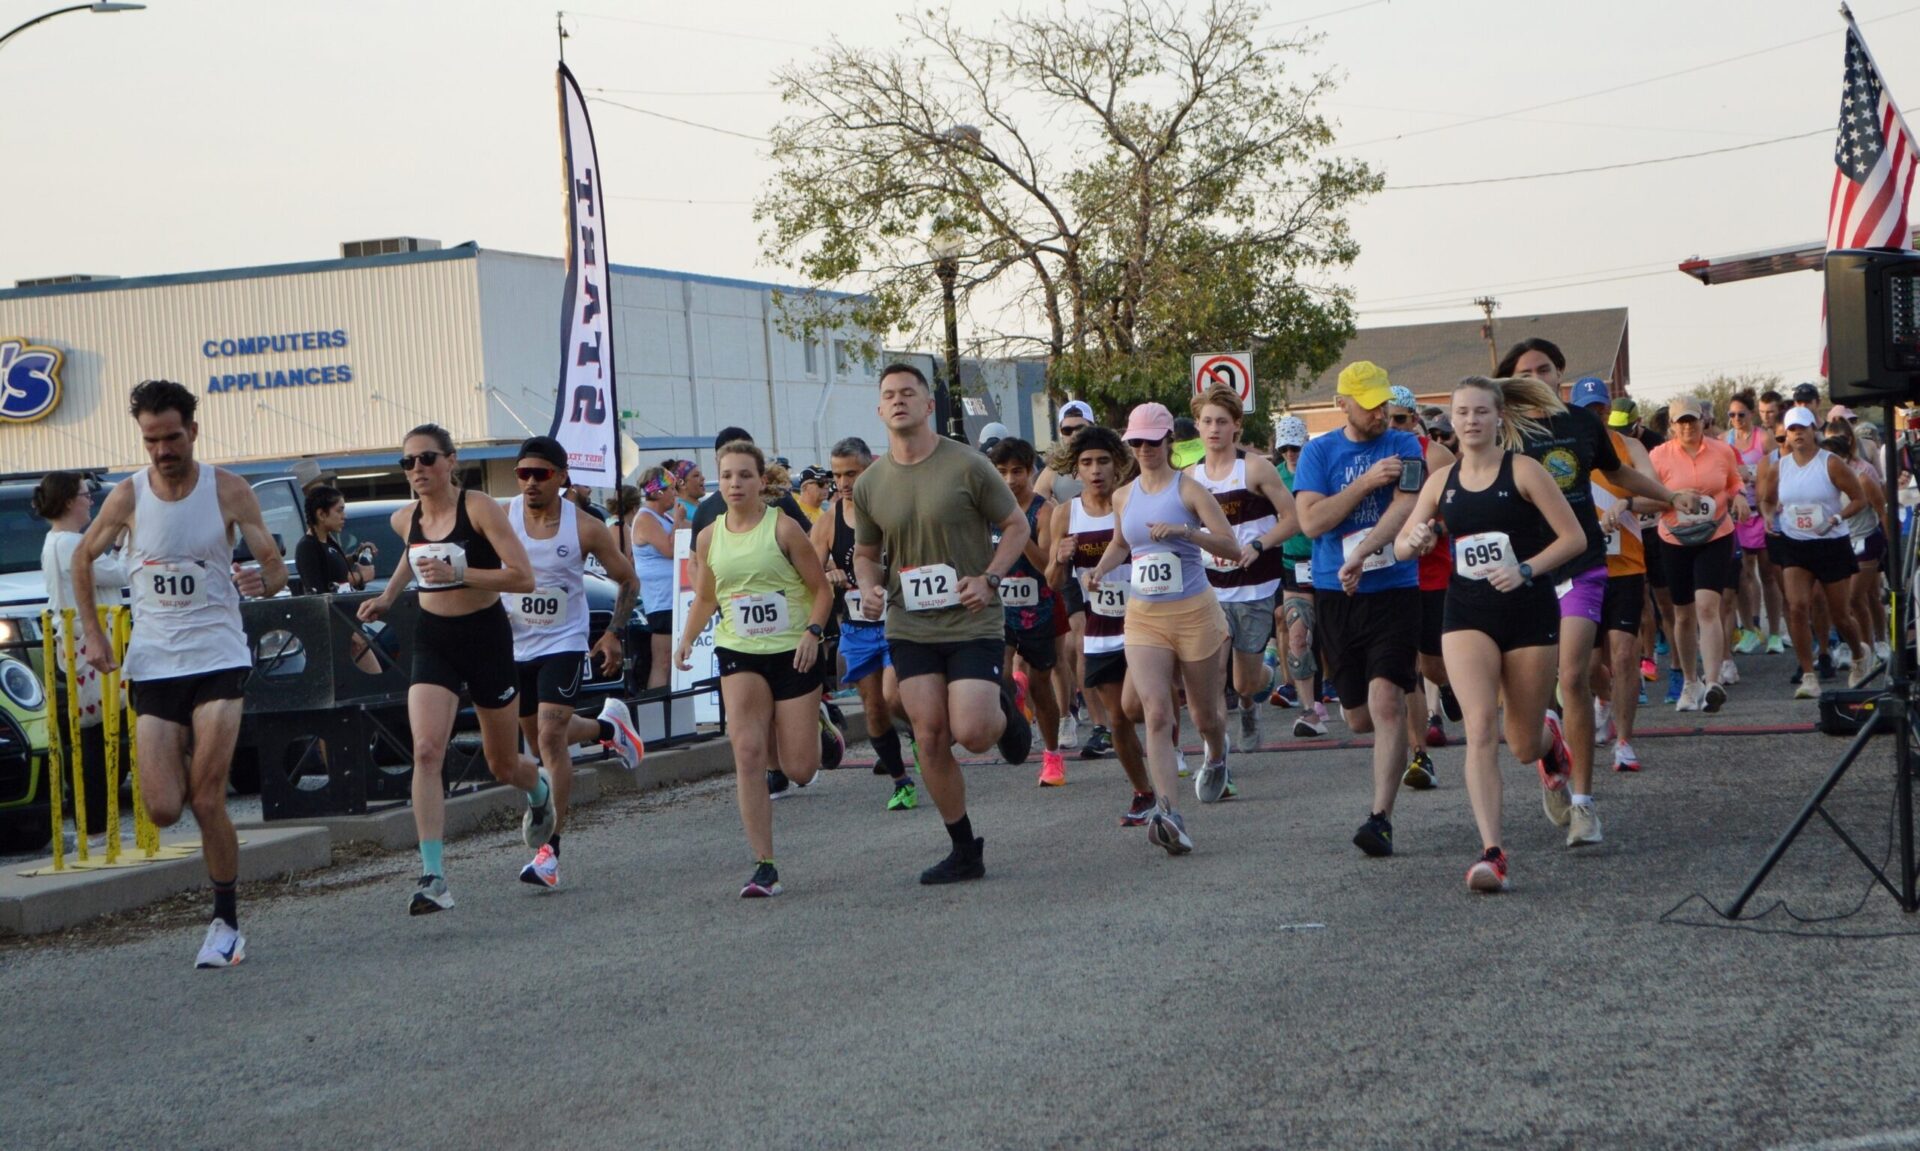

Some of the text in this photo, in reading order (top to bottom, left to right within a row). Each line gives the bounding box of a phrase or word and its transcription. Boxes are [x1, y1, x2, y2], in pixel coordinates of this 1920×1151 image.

[203, 330, 348, 359] COMPUTERS
[207, 365, 353, 394] APPLIANCES
[1584, 382, 1595, 392] T
[1464, 542, 1503, 567] 695
[1138, 563, 1172, 583] 703
[153, 574, 195, 596] 810
[909, 575, 949, 597] 712
[1000, 584, 1031, 598] 710
[521, 596, 559, 615] 809
[1096, 590, 1125, 606] 731
[739, 603, 778, 624] 705
